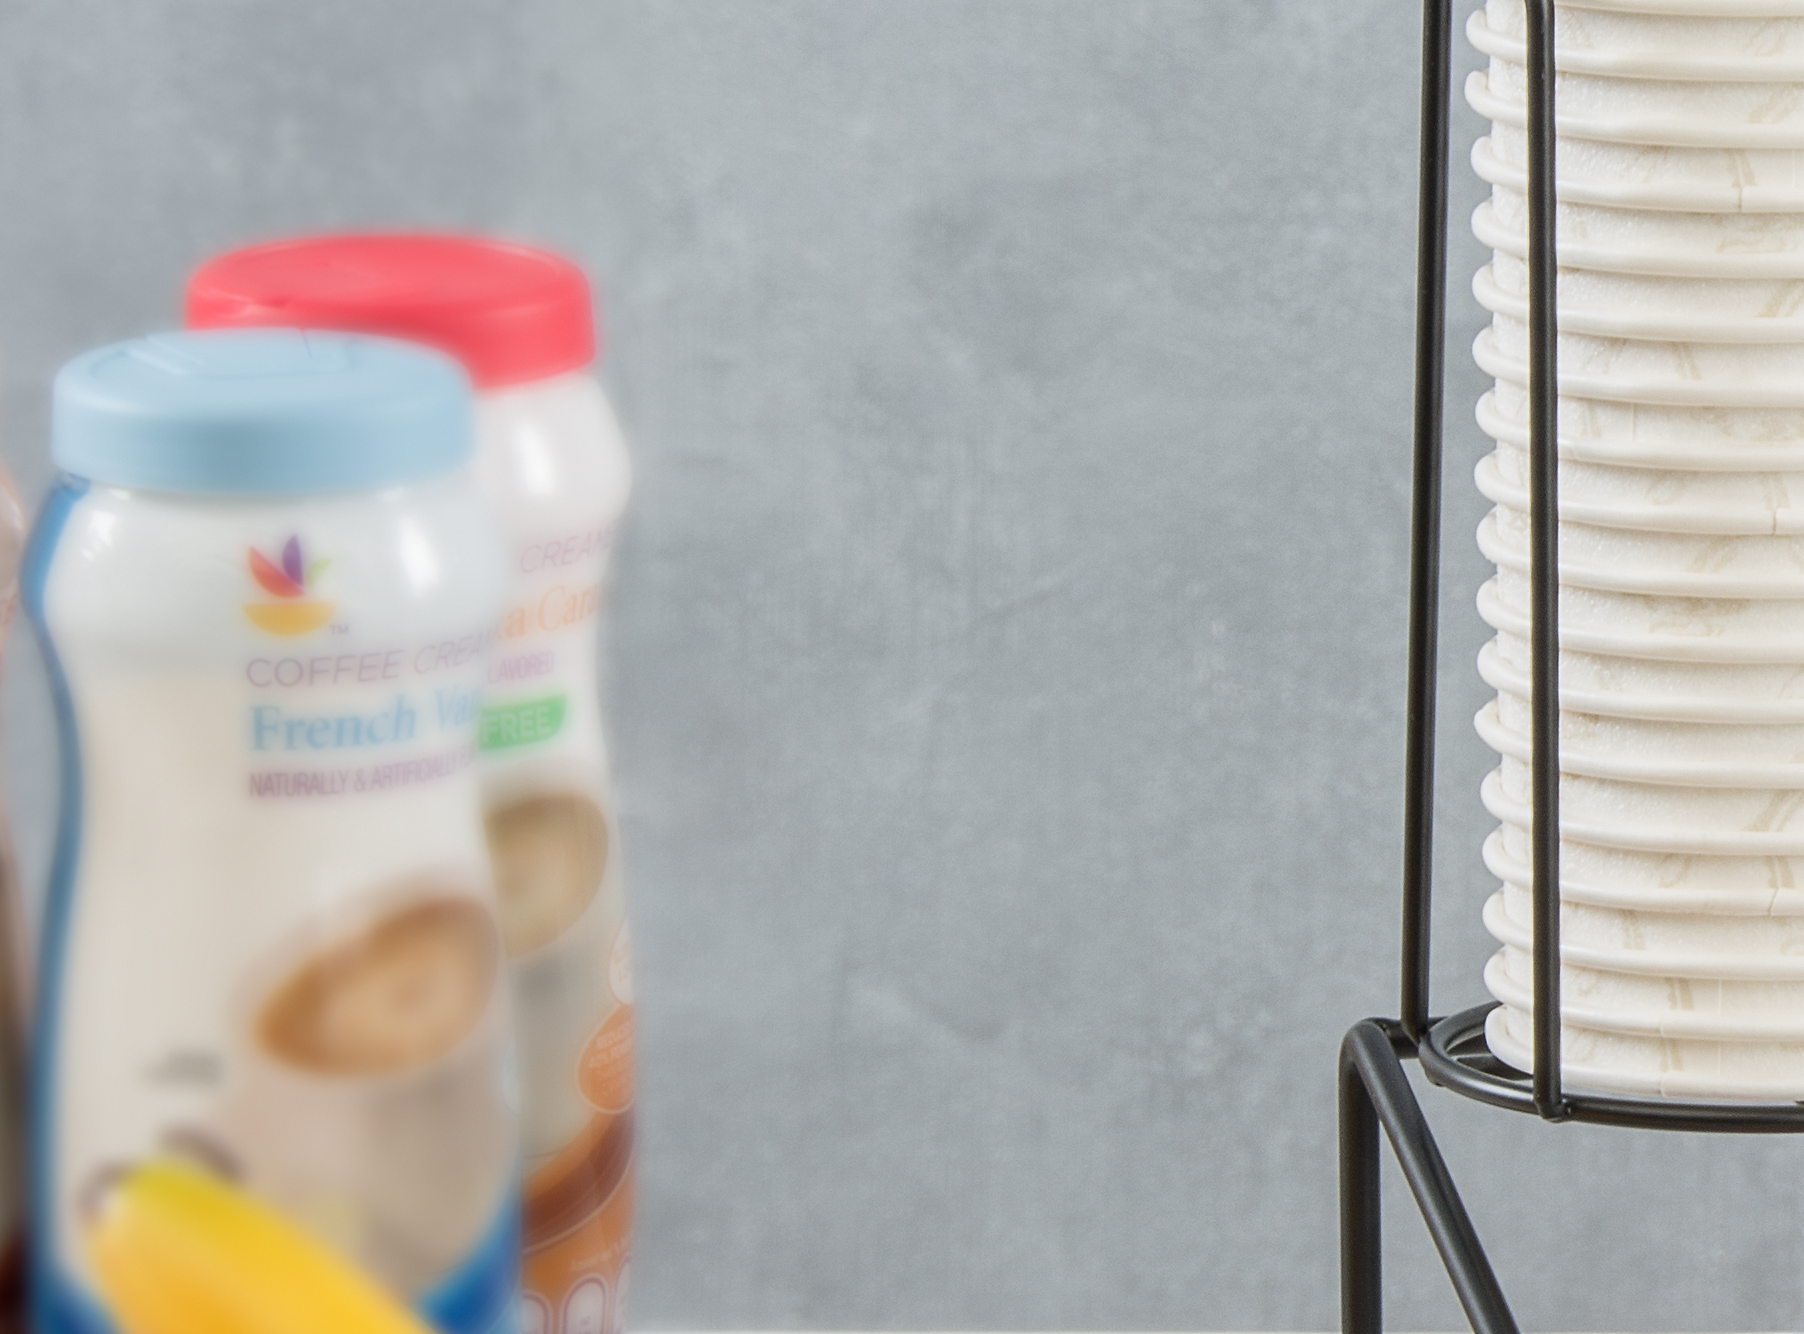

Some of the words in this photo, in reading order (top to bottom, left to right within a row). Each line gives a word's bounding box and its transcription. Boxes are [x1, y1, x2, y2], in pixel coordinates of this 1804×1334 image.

[246, 648, 406, 689] COFFEE
[248, 692, 417, 753] French
[248, 770, 348, 799] NATURALLY
[354, 767, 368, 792] &
